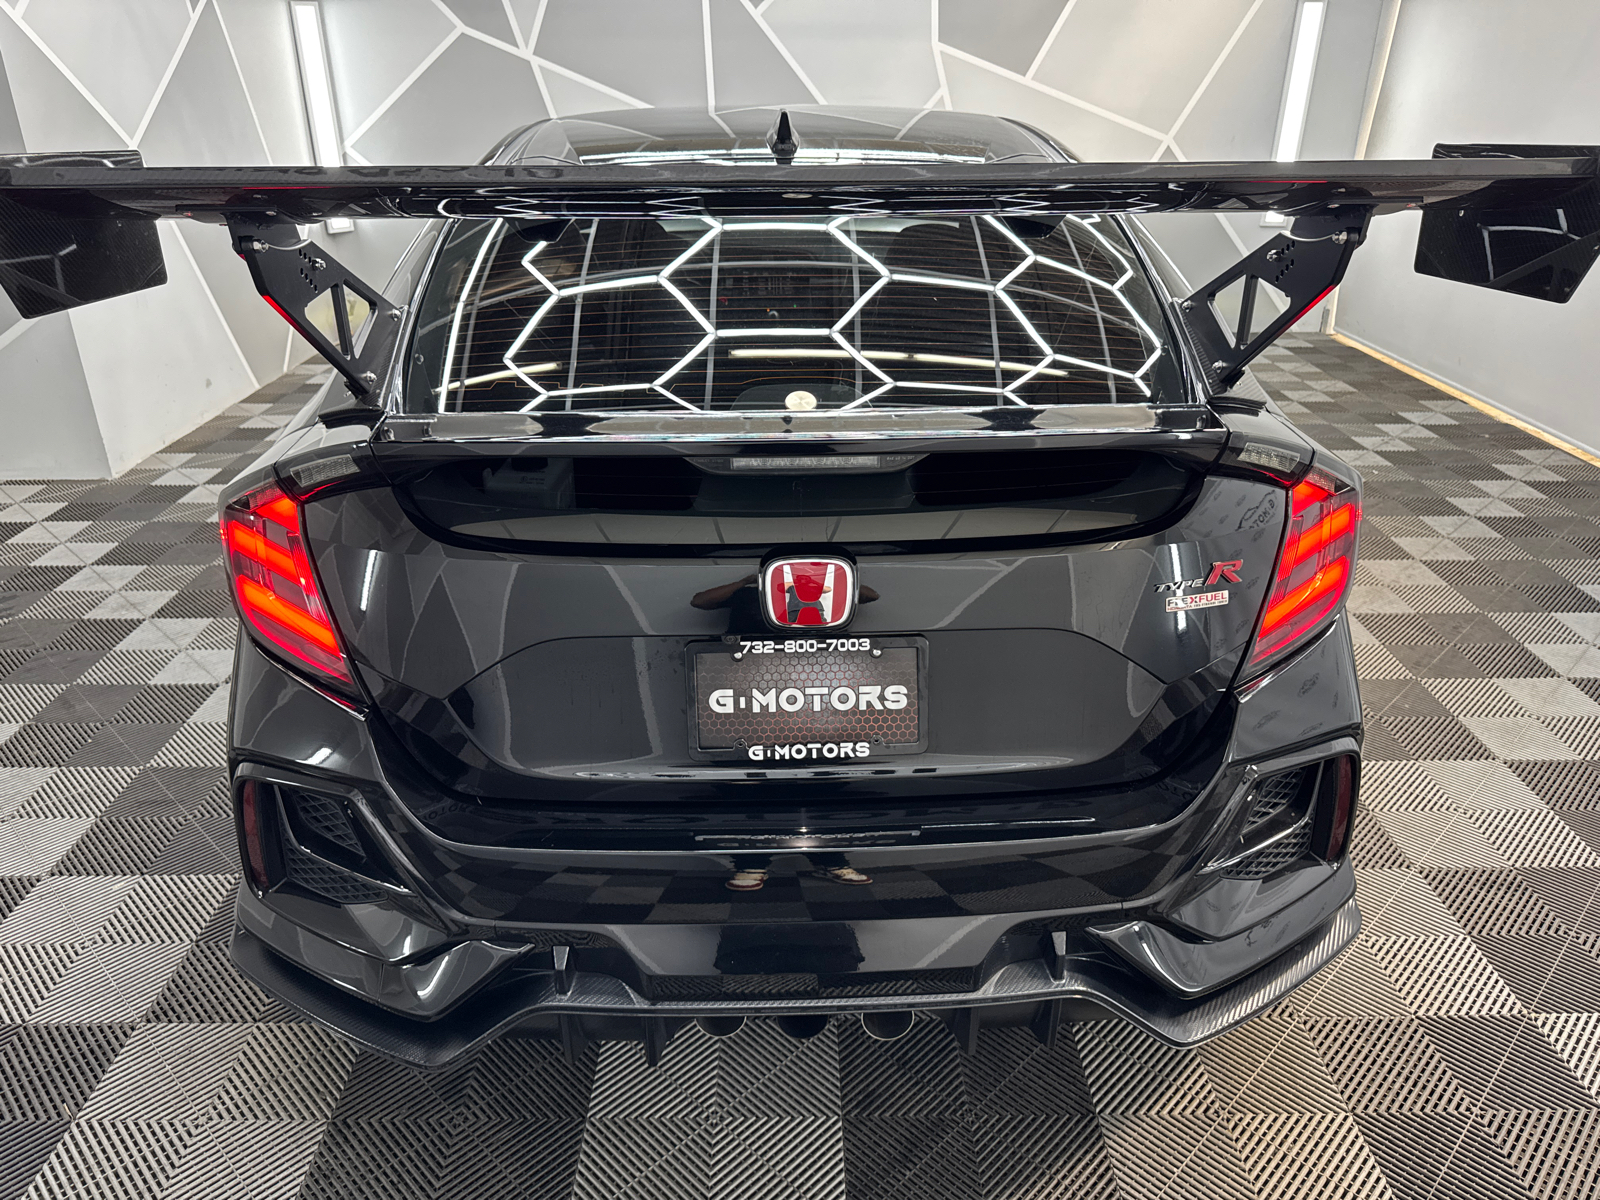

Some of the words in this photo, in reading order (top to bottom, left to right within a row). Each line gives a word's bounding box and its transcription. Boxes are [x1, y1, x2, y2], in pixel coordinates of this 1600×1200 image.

[1153, 578, 1204, 593] TYPE
[1204, 559, 1243, 586] R
[739, 638, 871, 654] 732-800-7003
